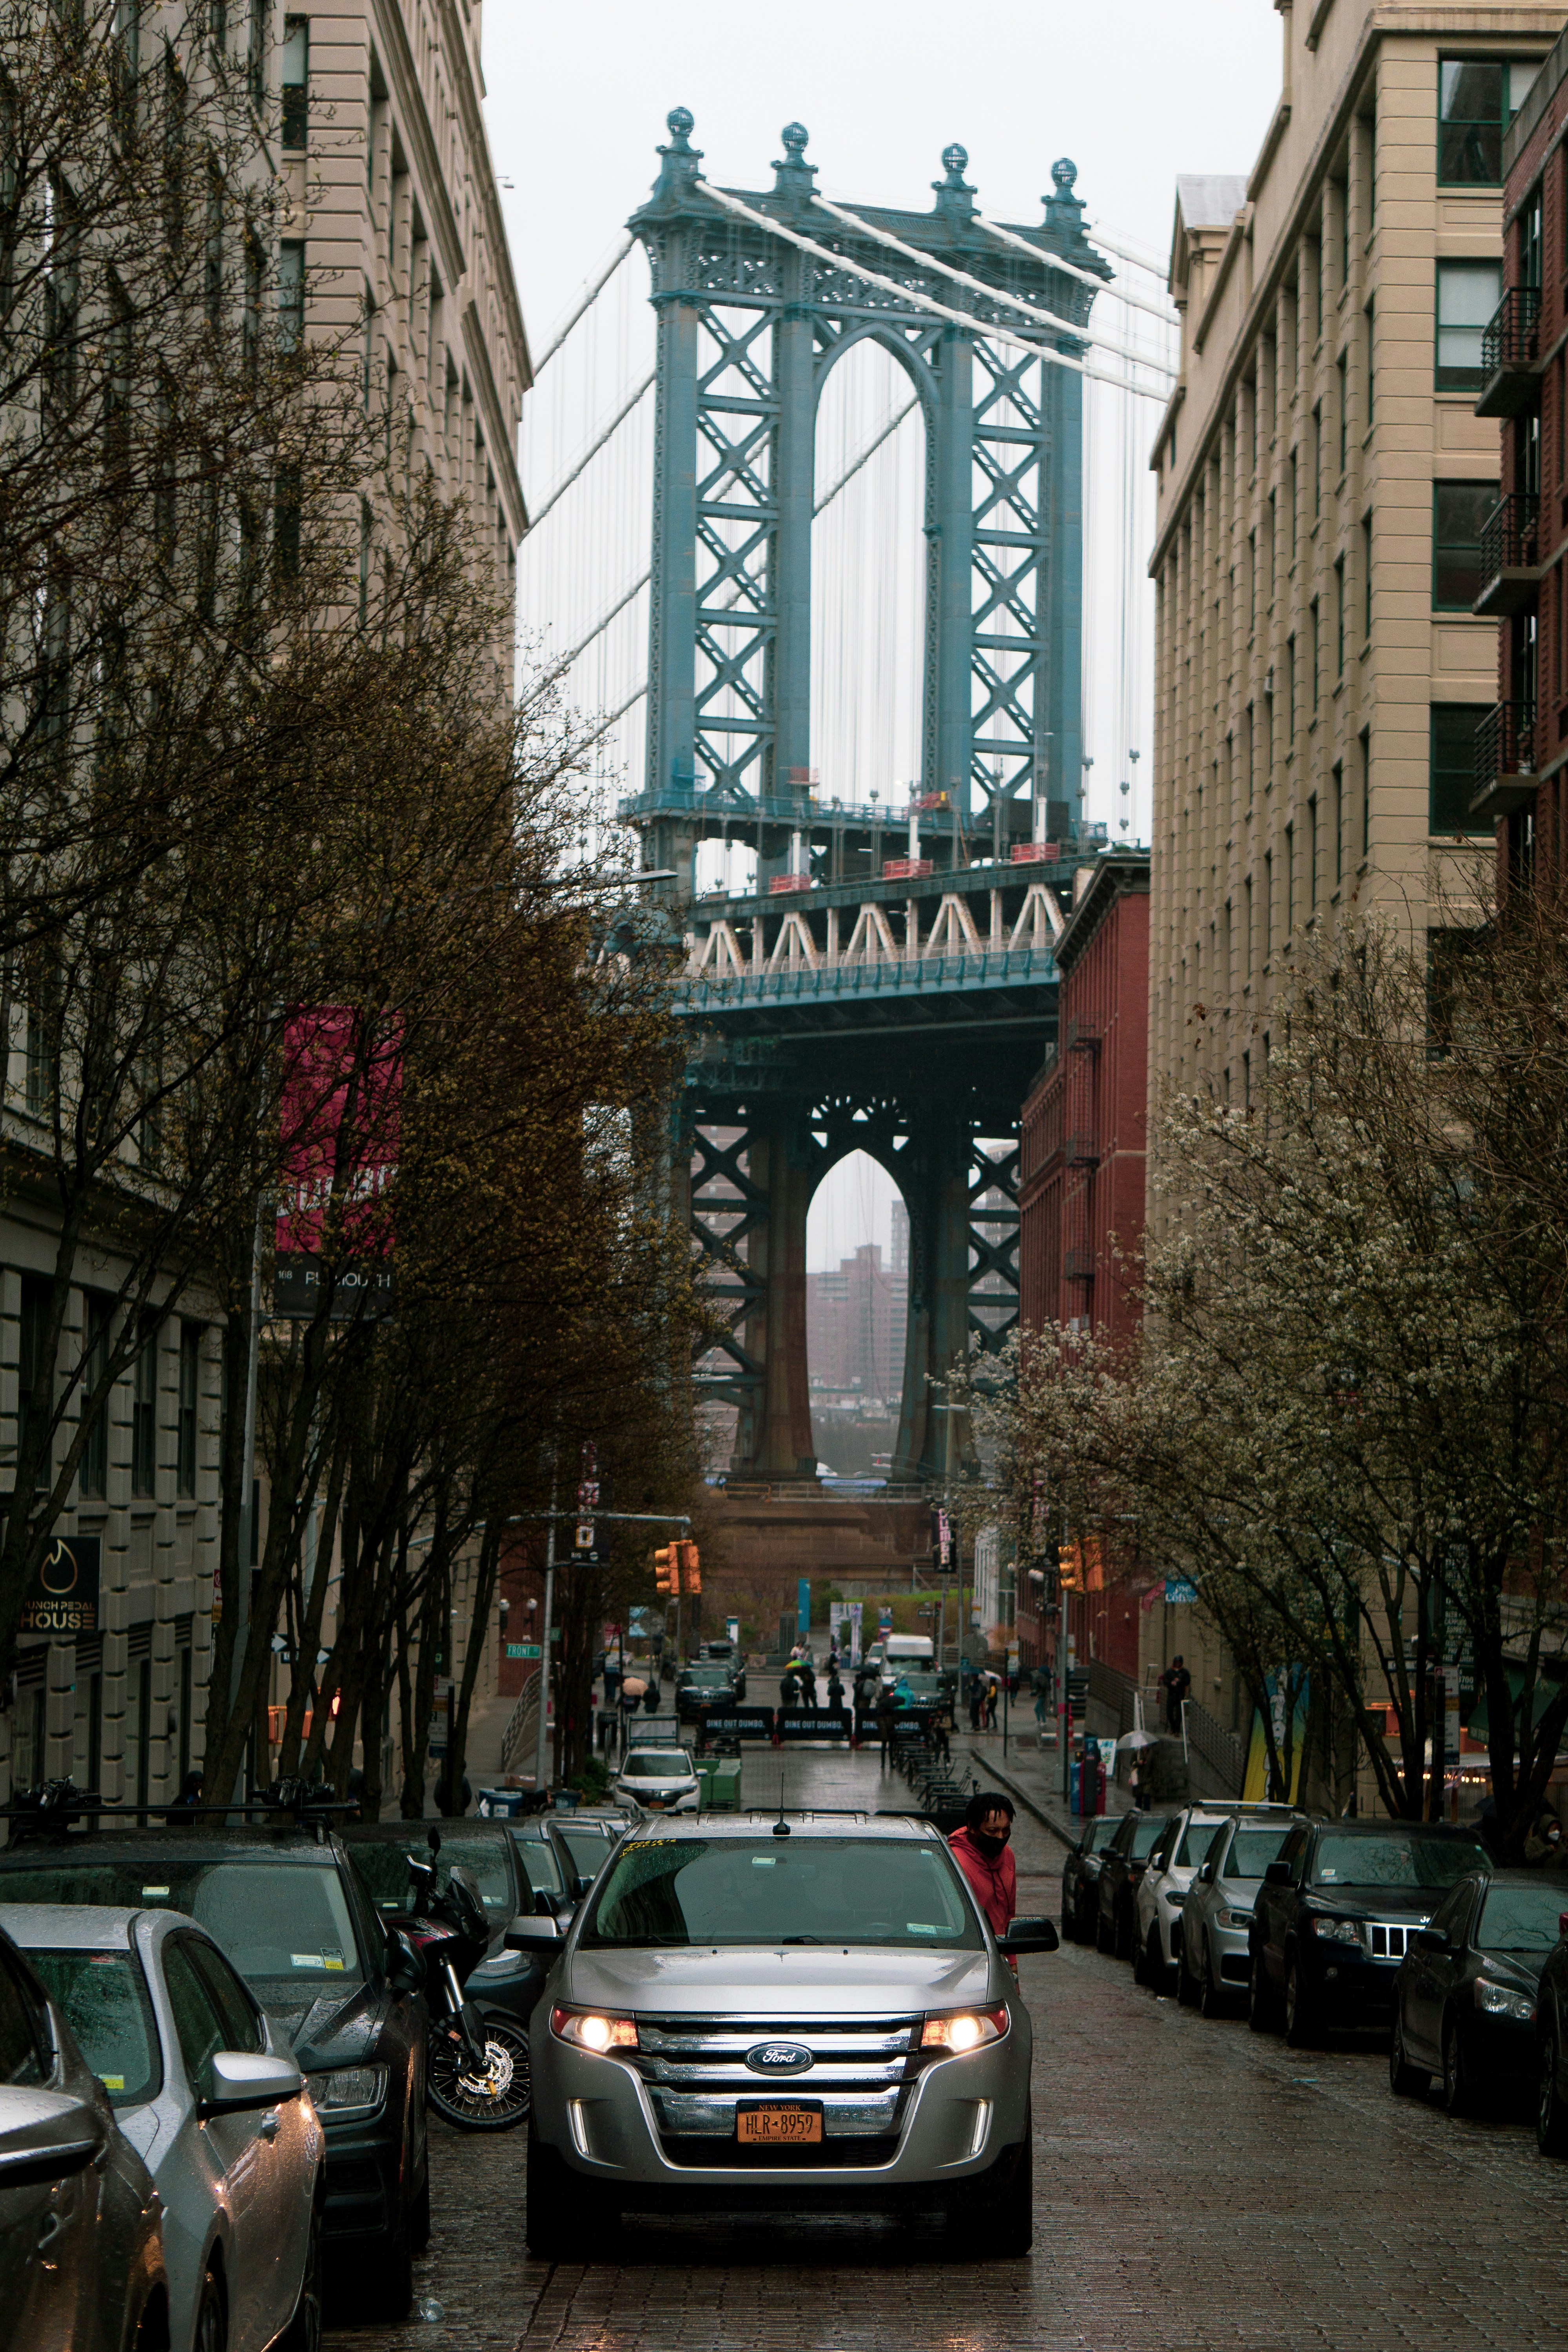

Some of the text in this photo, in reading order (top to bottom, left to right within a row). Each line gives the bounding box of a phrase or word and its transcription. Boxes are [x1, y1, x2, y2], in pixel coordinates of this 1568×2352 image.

[61, 1601, 94, 1611] PEDAL
[20, 1612, 95, 1630] HOUSE
[508, 1646, 529, 1656] FRONT
[706, 1719, 722, 1728] DINE
[724, 1719, 737, 1728] OUT
[785, 1720, 801, 1729] DINE
[802, 1720, 815, 1729] OUT
[763, 2049, 796, 2062] Ford
[746, 2113, 813, 2134] HLR 8959
